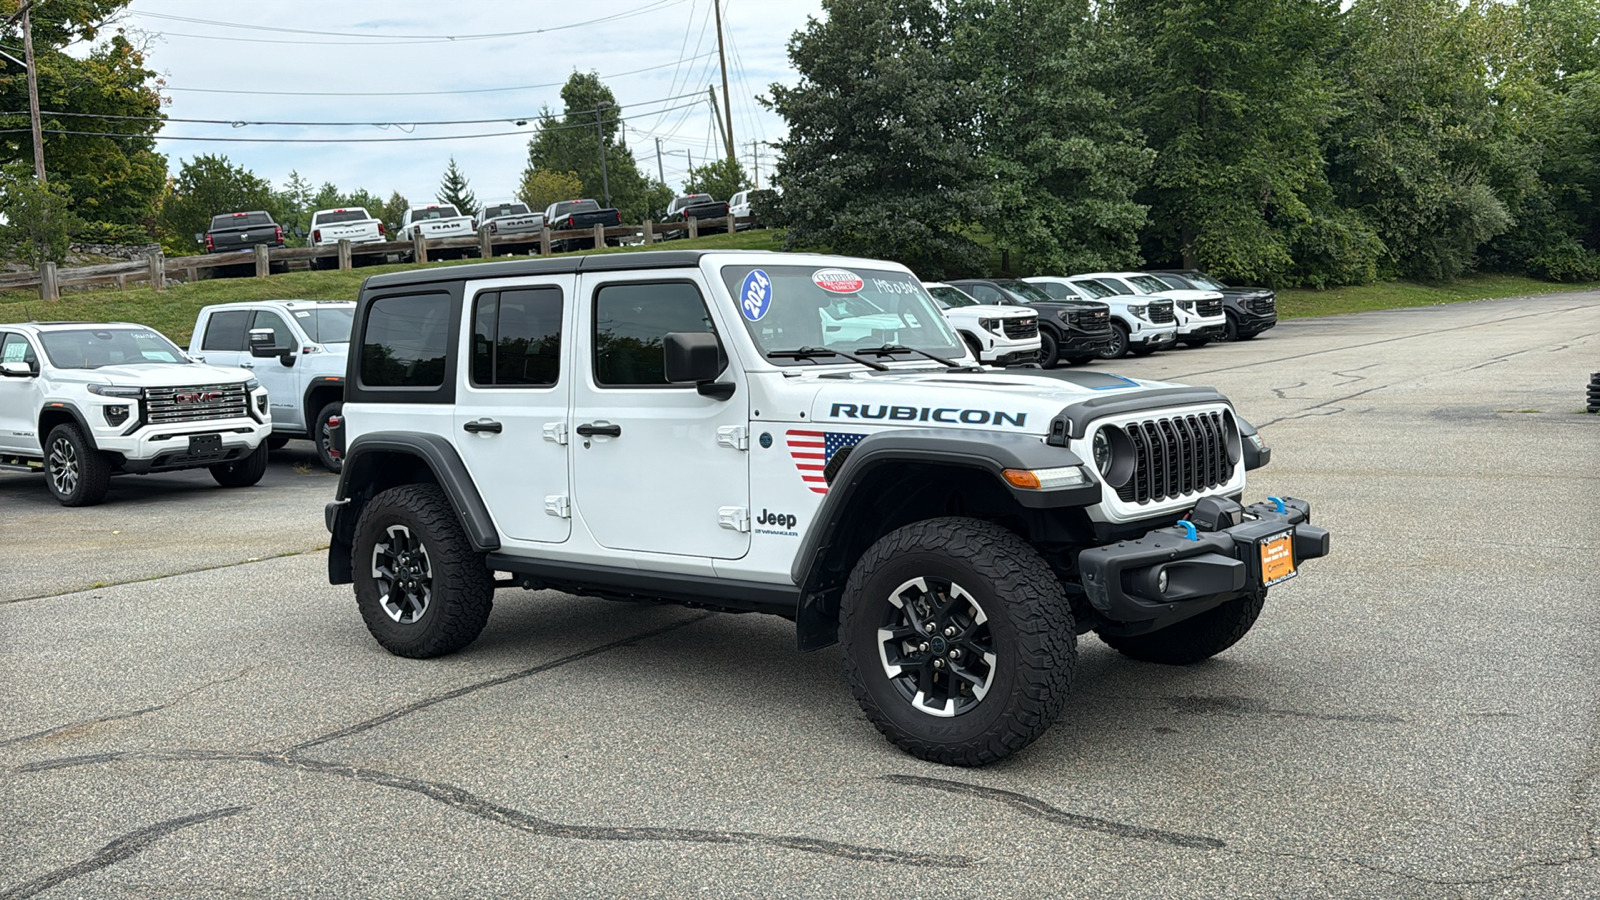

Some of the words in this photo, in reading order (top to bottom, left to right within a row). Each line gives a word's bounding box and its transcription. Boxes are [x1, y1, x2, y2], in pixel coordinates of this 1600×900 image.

[816, 273, 857, 281] CERTIFIED
[744, 271, 769, 318] 2024
[176, 392, 223, 404] GMC
[829, 403, 1027, 427] RUBICON
[756, 508, 797, 530] Jeep
[761, 529, 799, 537] WRANGLER
